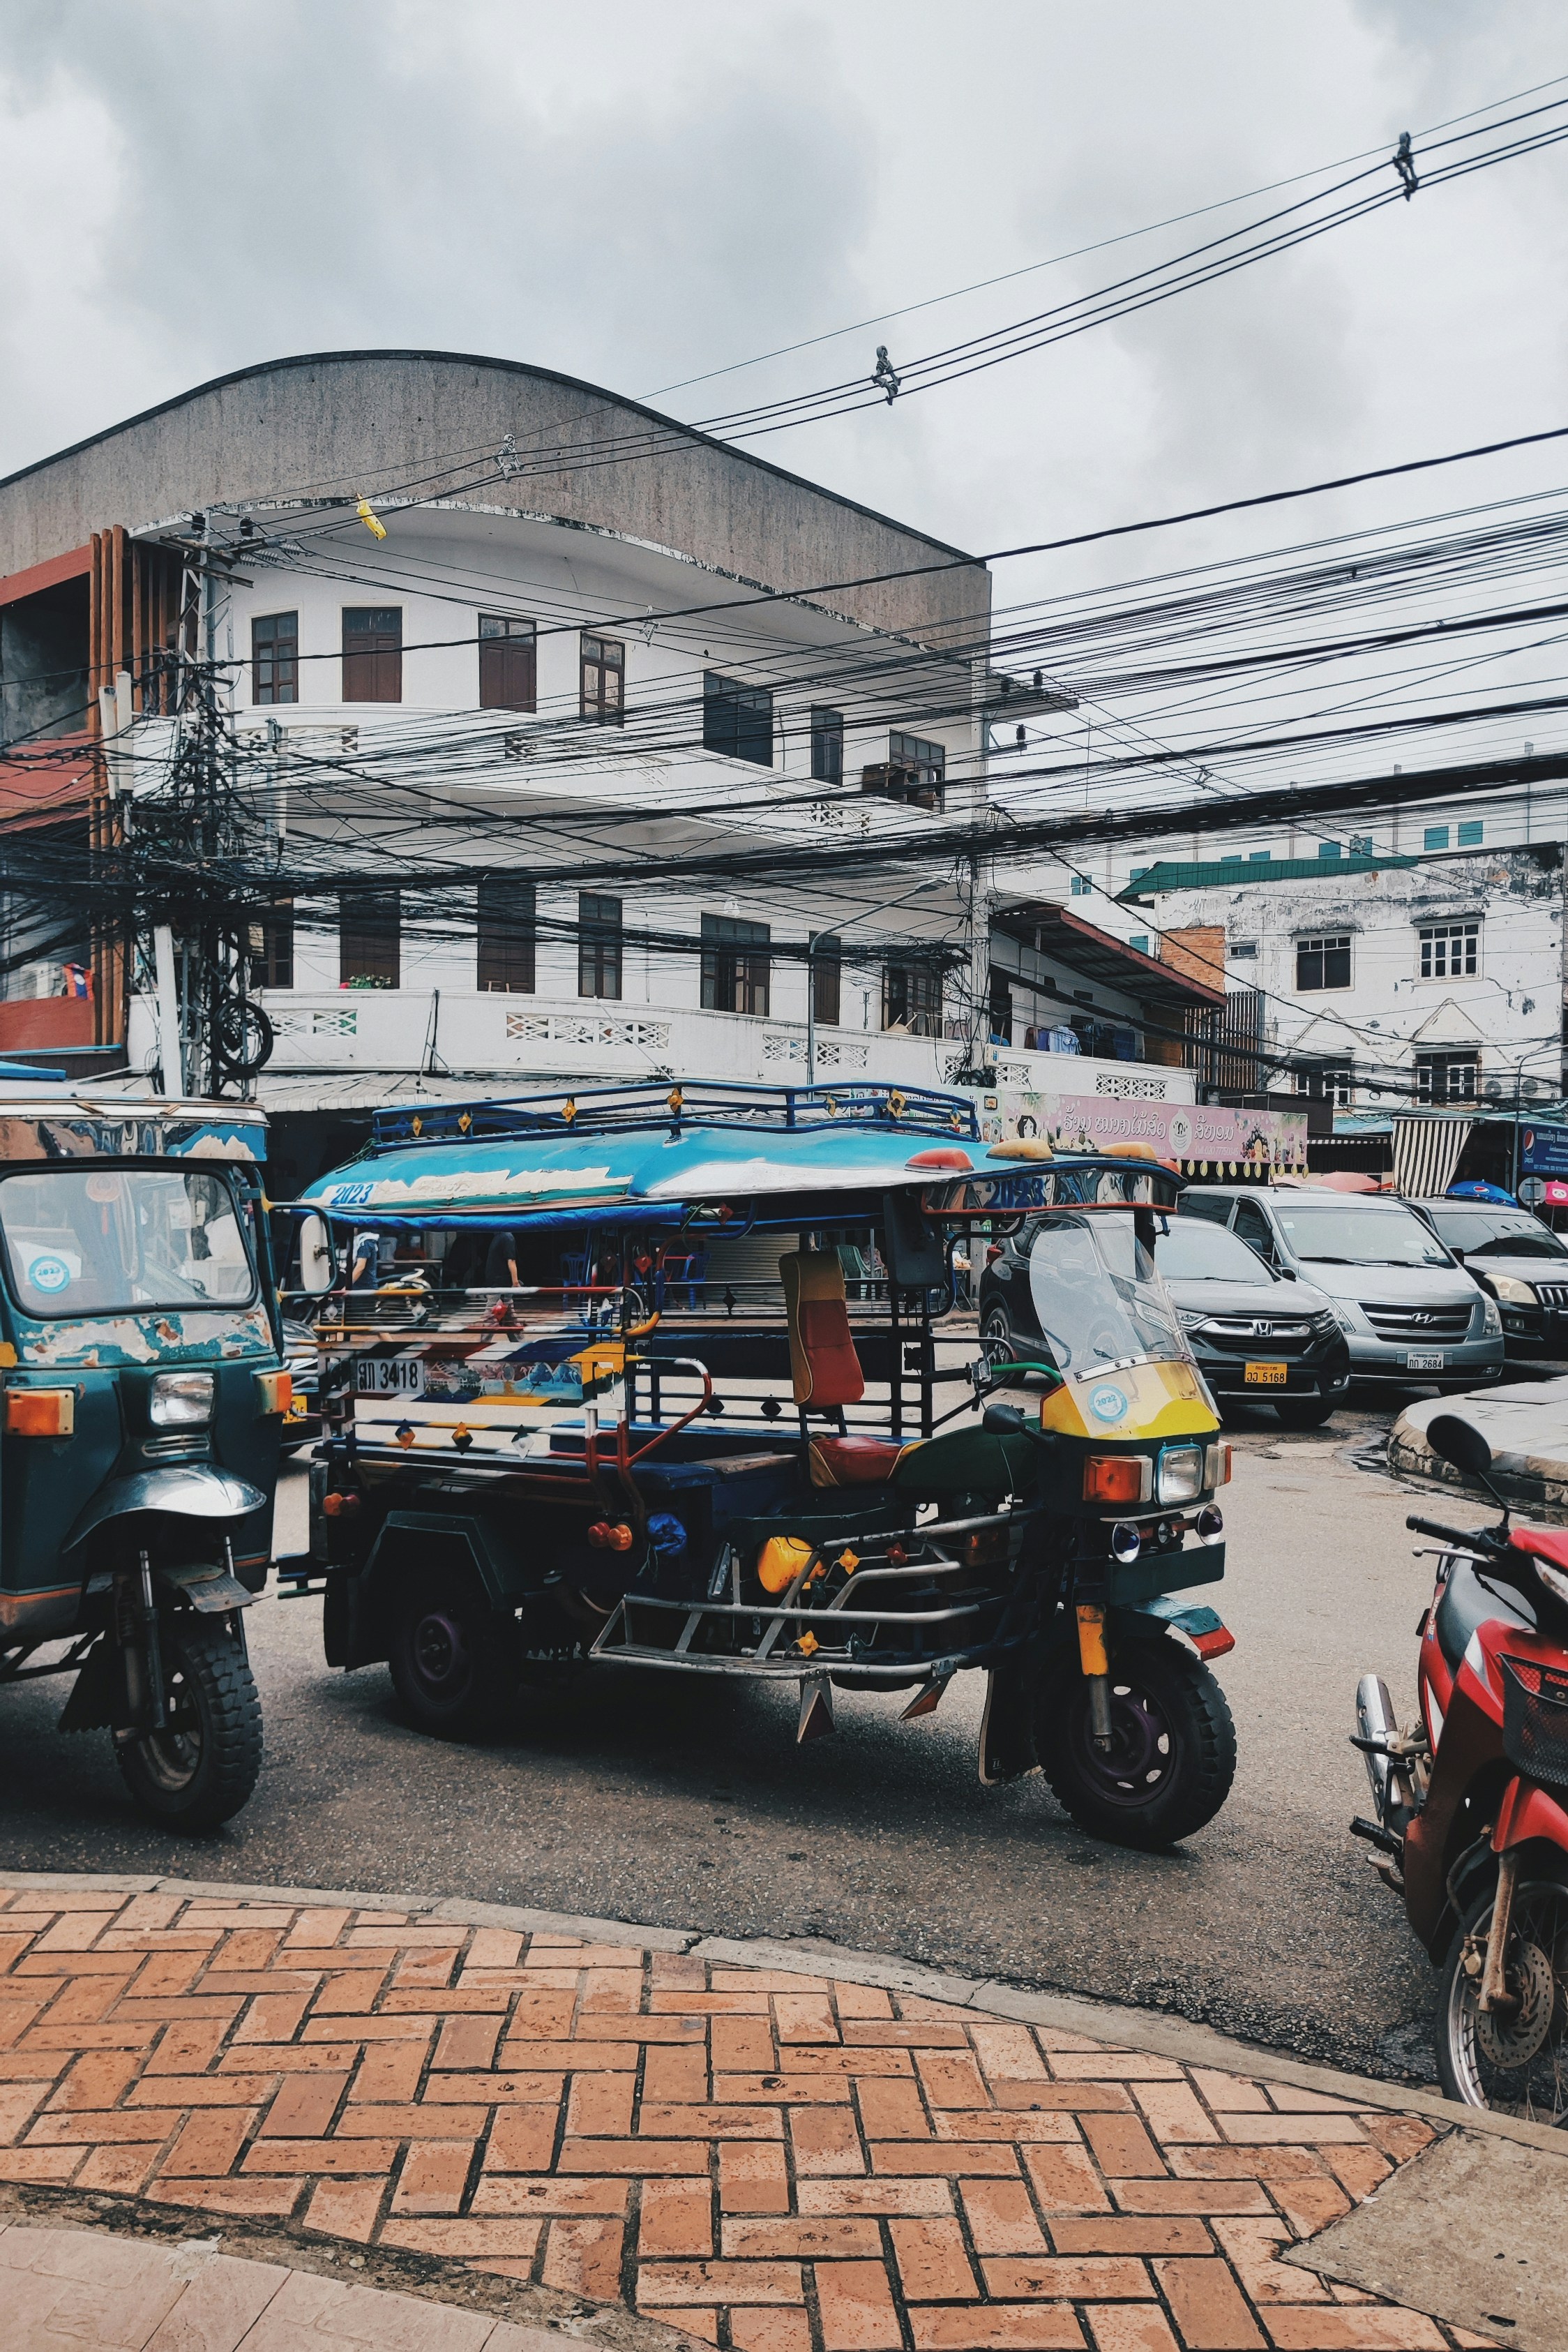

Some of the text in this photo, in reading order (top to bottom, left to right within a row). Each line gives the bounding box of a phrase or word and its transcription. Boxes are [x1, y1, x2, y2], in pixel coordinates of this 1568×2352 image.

[331, 1183, 374, 1204] 2023
[1422, 1359, 1442, 1368] 2684
[379, 1362, 418, 1390] 3418
[1262, 1372, 1285, 1383] 5168
[1095, 1394, 1117, 1407] 2022
